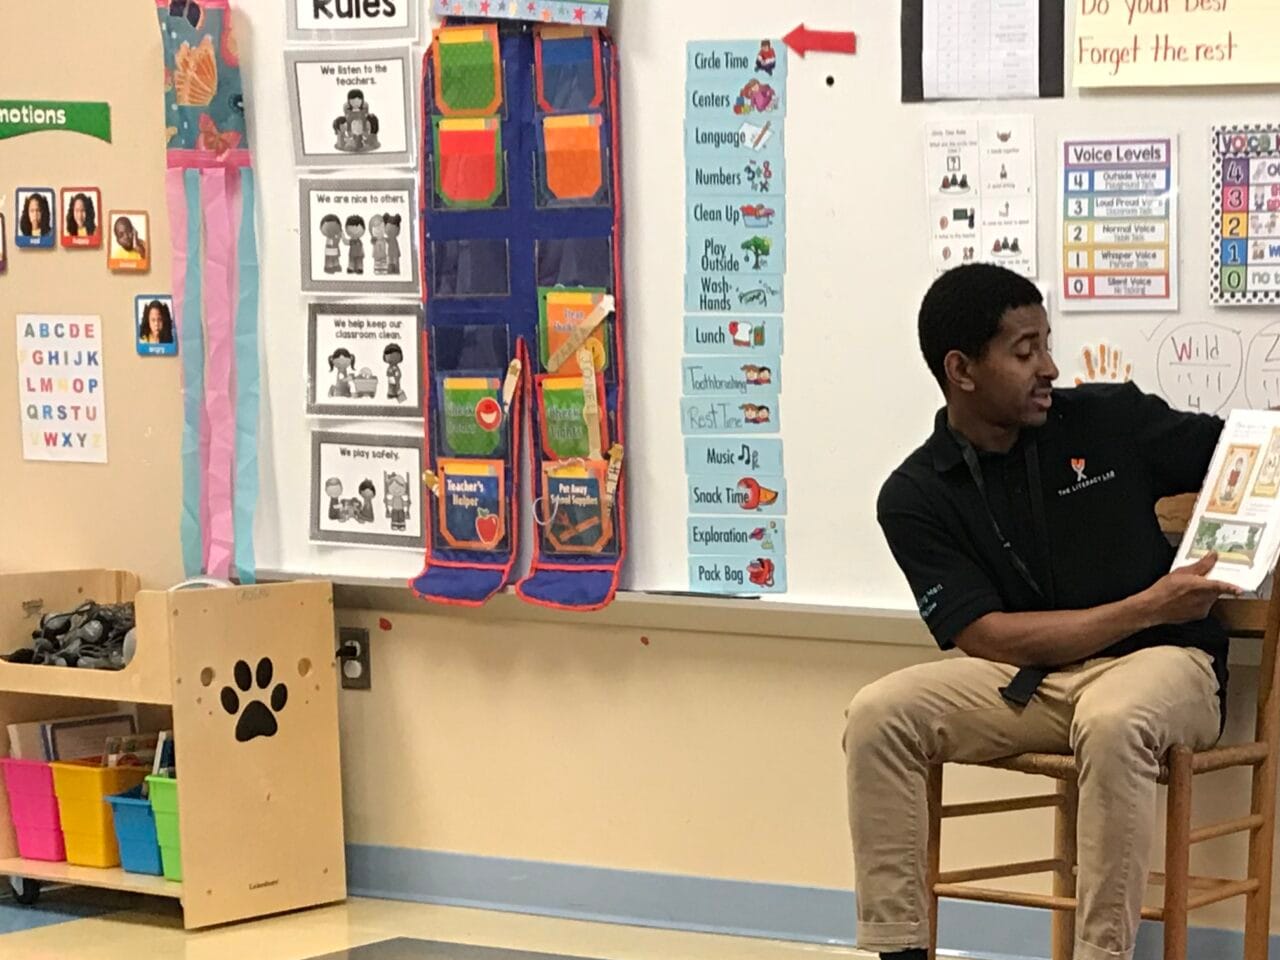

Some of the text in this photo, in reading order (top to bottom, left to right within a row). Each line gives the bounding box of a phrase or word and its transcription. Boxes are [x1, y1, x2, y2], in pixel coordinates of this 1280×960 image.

[694, 51, 749, 69] Circle Time
[1078, 30, 1238, 76] Forget the rest
[320, 64, 387, 74] We listen to the
[336, 77, 376, 86] teachers.
[692, 90, 730, 108] Centers
[0, 105, 66, 124] motions
[695, 127, 746, 148] Language
[1073, 145, 1162, 163] Voice Levels
[695, 167, 741, 185] Numbers
[1074, 173, 1083, 189] 4
[1227, 161, 1243, 183] 4
[316, 193, 405, 203] We are nice to others.
[1229, 189, 1242, 208] 3
[694, 202, 740, 225] Clean Up
[1074, 200, 1083, 216] 3
[1073, 226, 1082, 241] 2
[1228, 217, 1241, 237] 2
[704, 238, 726, 258] Play
[1228, 244, 1239, 264] 1
[701, 254, 740, 272] Outside
[701, 276, 729, 294] Wash
[1227, 270, 1241, 290] 0
[700, 293, 731, 311] Hands
[334, 319, 346, 328] We
[348, 319, 365, 330] help
[366, 319, 387, 331] keep
[335, 331, 402, 339] classroom clean.
[695, 325, 725, 344] Lunch
[1170, 334, 1220, 362] Wild
[339, 447, 399, 461] We play safely.
[706, 448, 735, 465] Music
[446, 479, 484, 492] Teacher's
[1058, 487, 1071, 496] THE
[452, 493, 479, 509] Helper
[693, 486, 749, 504] Snack Time
[692, 525, 748, 546] Exploration
[698, 564, 743, 584] Pack Bag
